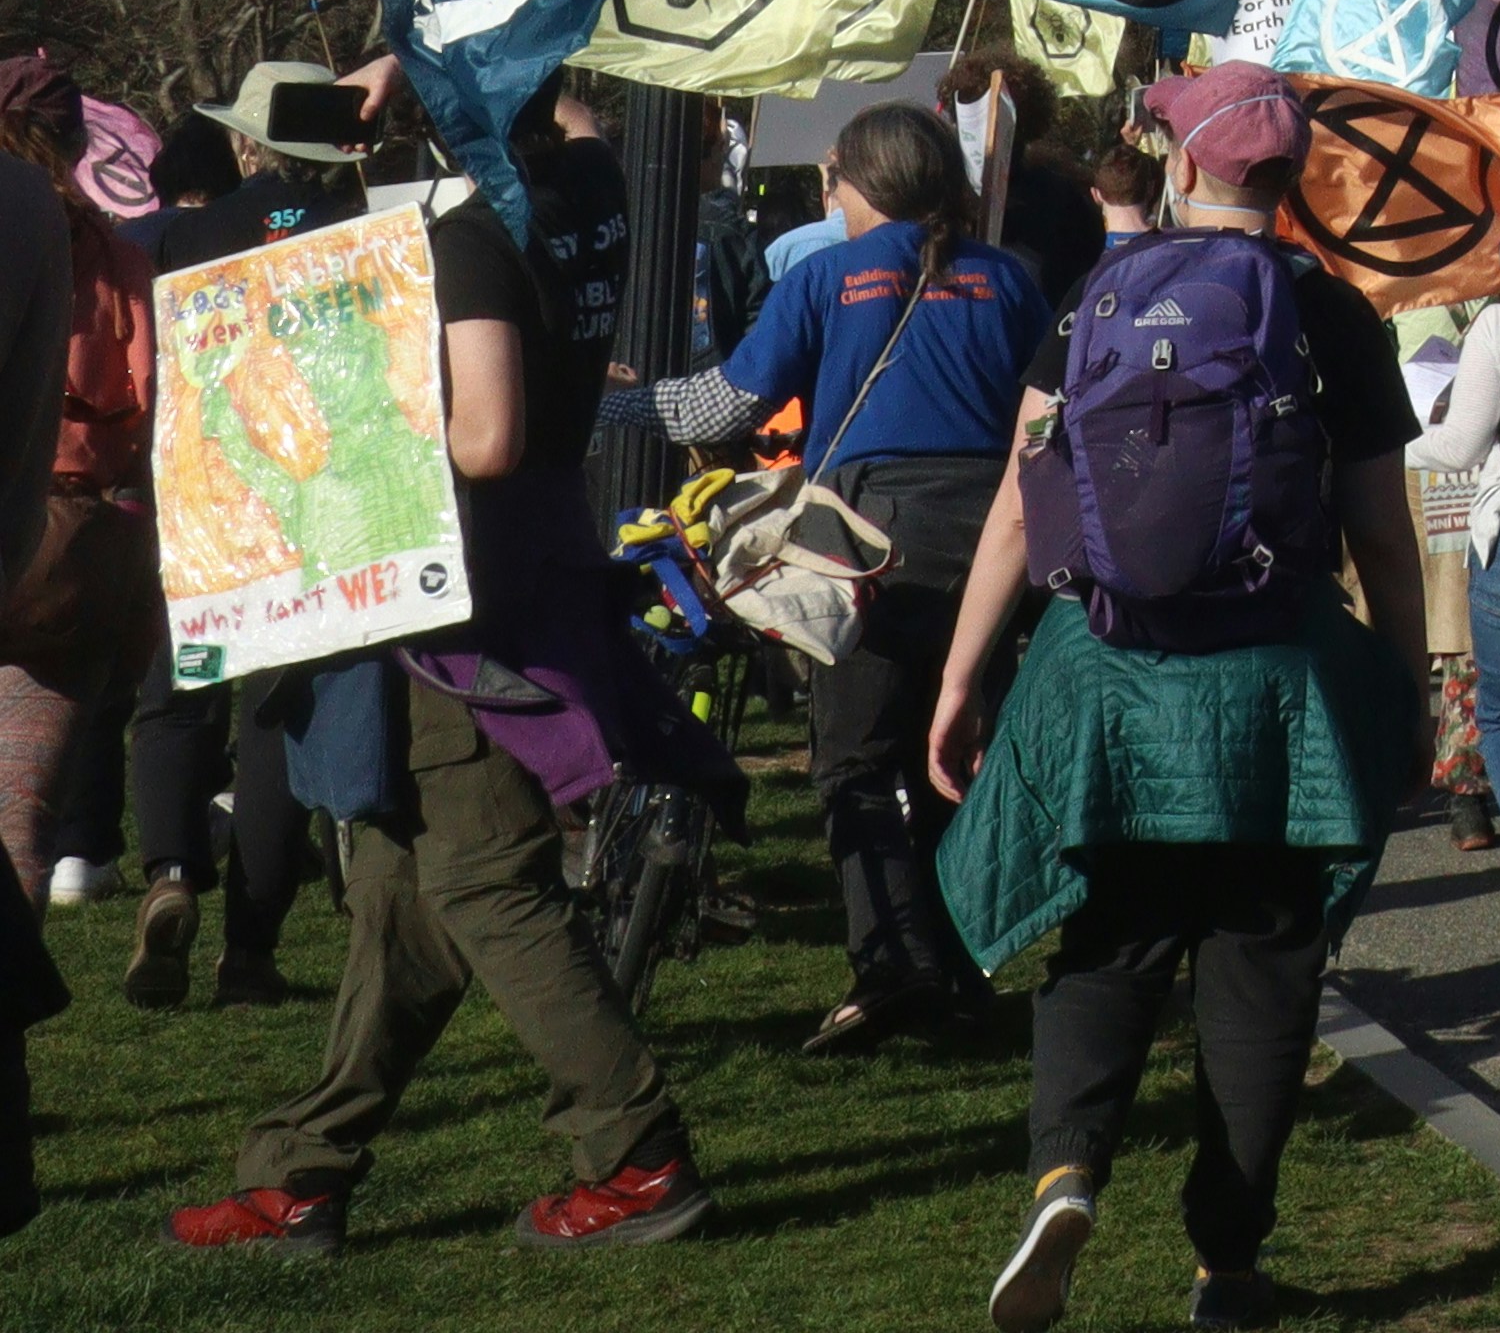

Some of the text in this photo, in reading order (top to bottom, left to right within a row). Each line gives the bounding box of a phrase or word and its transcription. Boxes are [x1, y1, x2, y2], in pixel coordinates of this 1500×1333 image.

[1231, 12, 1284, 36] Earth
[1134, 316, 1193, 328] GREGORY
[336, 560, 399, 612] WE?
